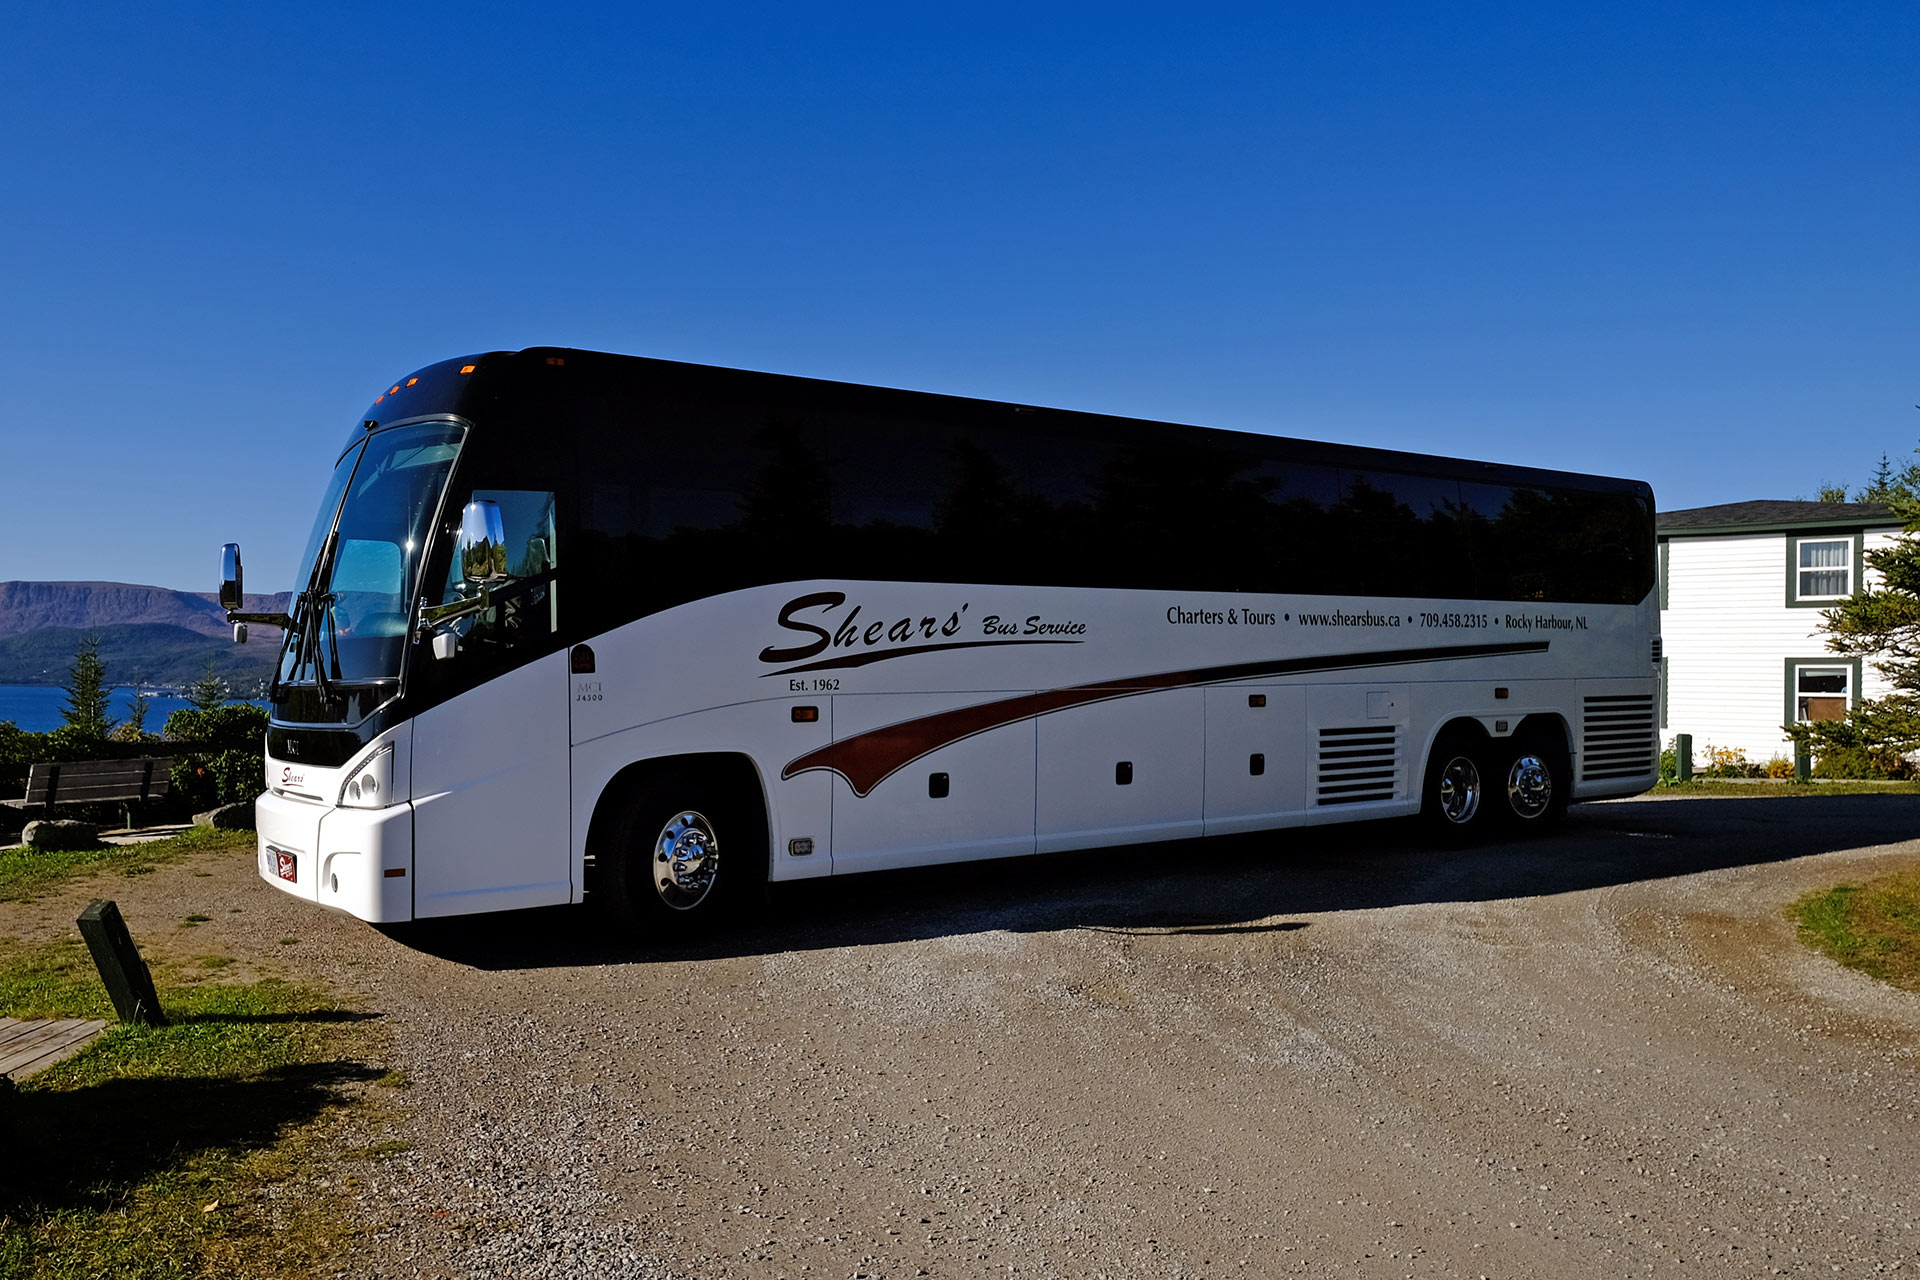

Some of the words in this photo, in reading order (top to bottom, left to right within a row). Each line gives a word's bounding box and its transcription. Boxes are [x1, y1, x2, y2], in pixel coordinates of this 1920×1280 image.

[1167, 605, 1223, 625] Charters
[1227, 608, 1238, 625] &
[1241, 608, 1276, 625] Tours
[1298, 609, 1401, 628] www.shearsbus.ca
[1420, 612, 1488, 629] 709.458.2315
[1505, 614, 1533, 633] Rocky
[1535, 615, 1574, 632] Harbour,
[1576, 616, 1588, 630] NL
[758, 591, 969, 663] Shears'
[982, 615, 1018, 635] Bus
[1023, 615, 1087, 635] Service
[577, 682, 602, 693] MCI
[789, 678, 808, 691] Est.
[812, 678, 840, 691] 1962
[576, 694, 603, 702] J4500
